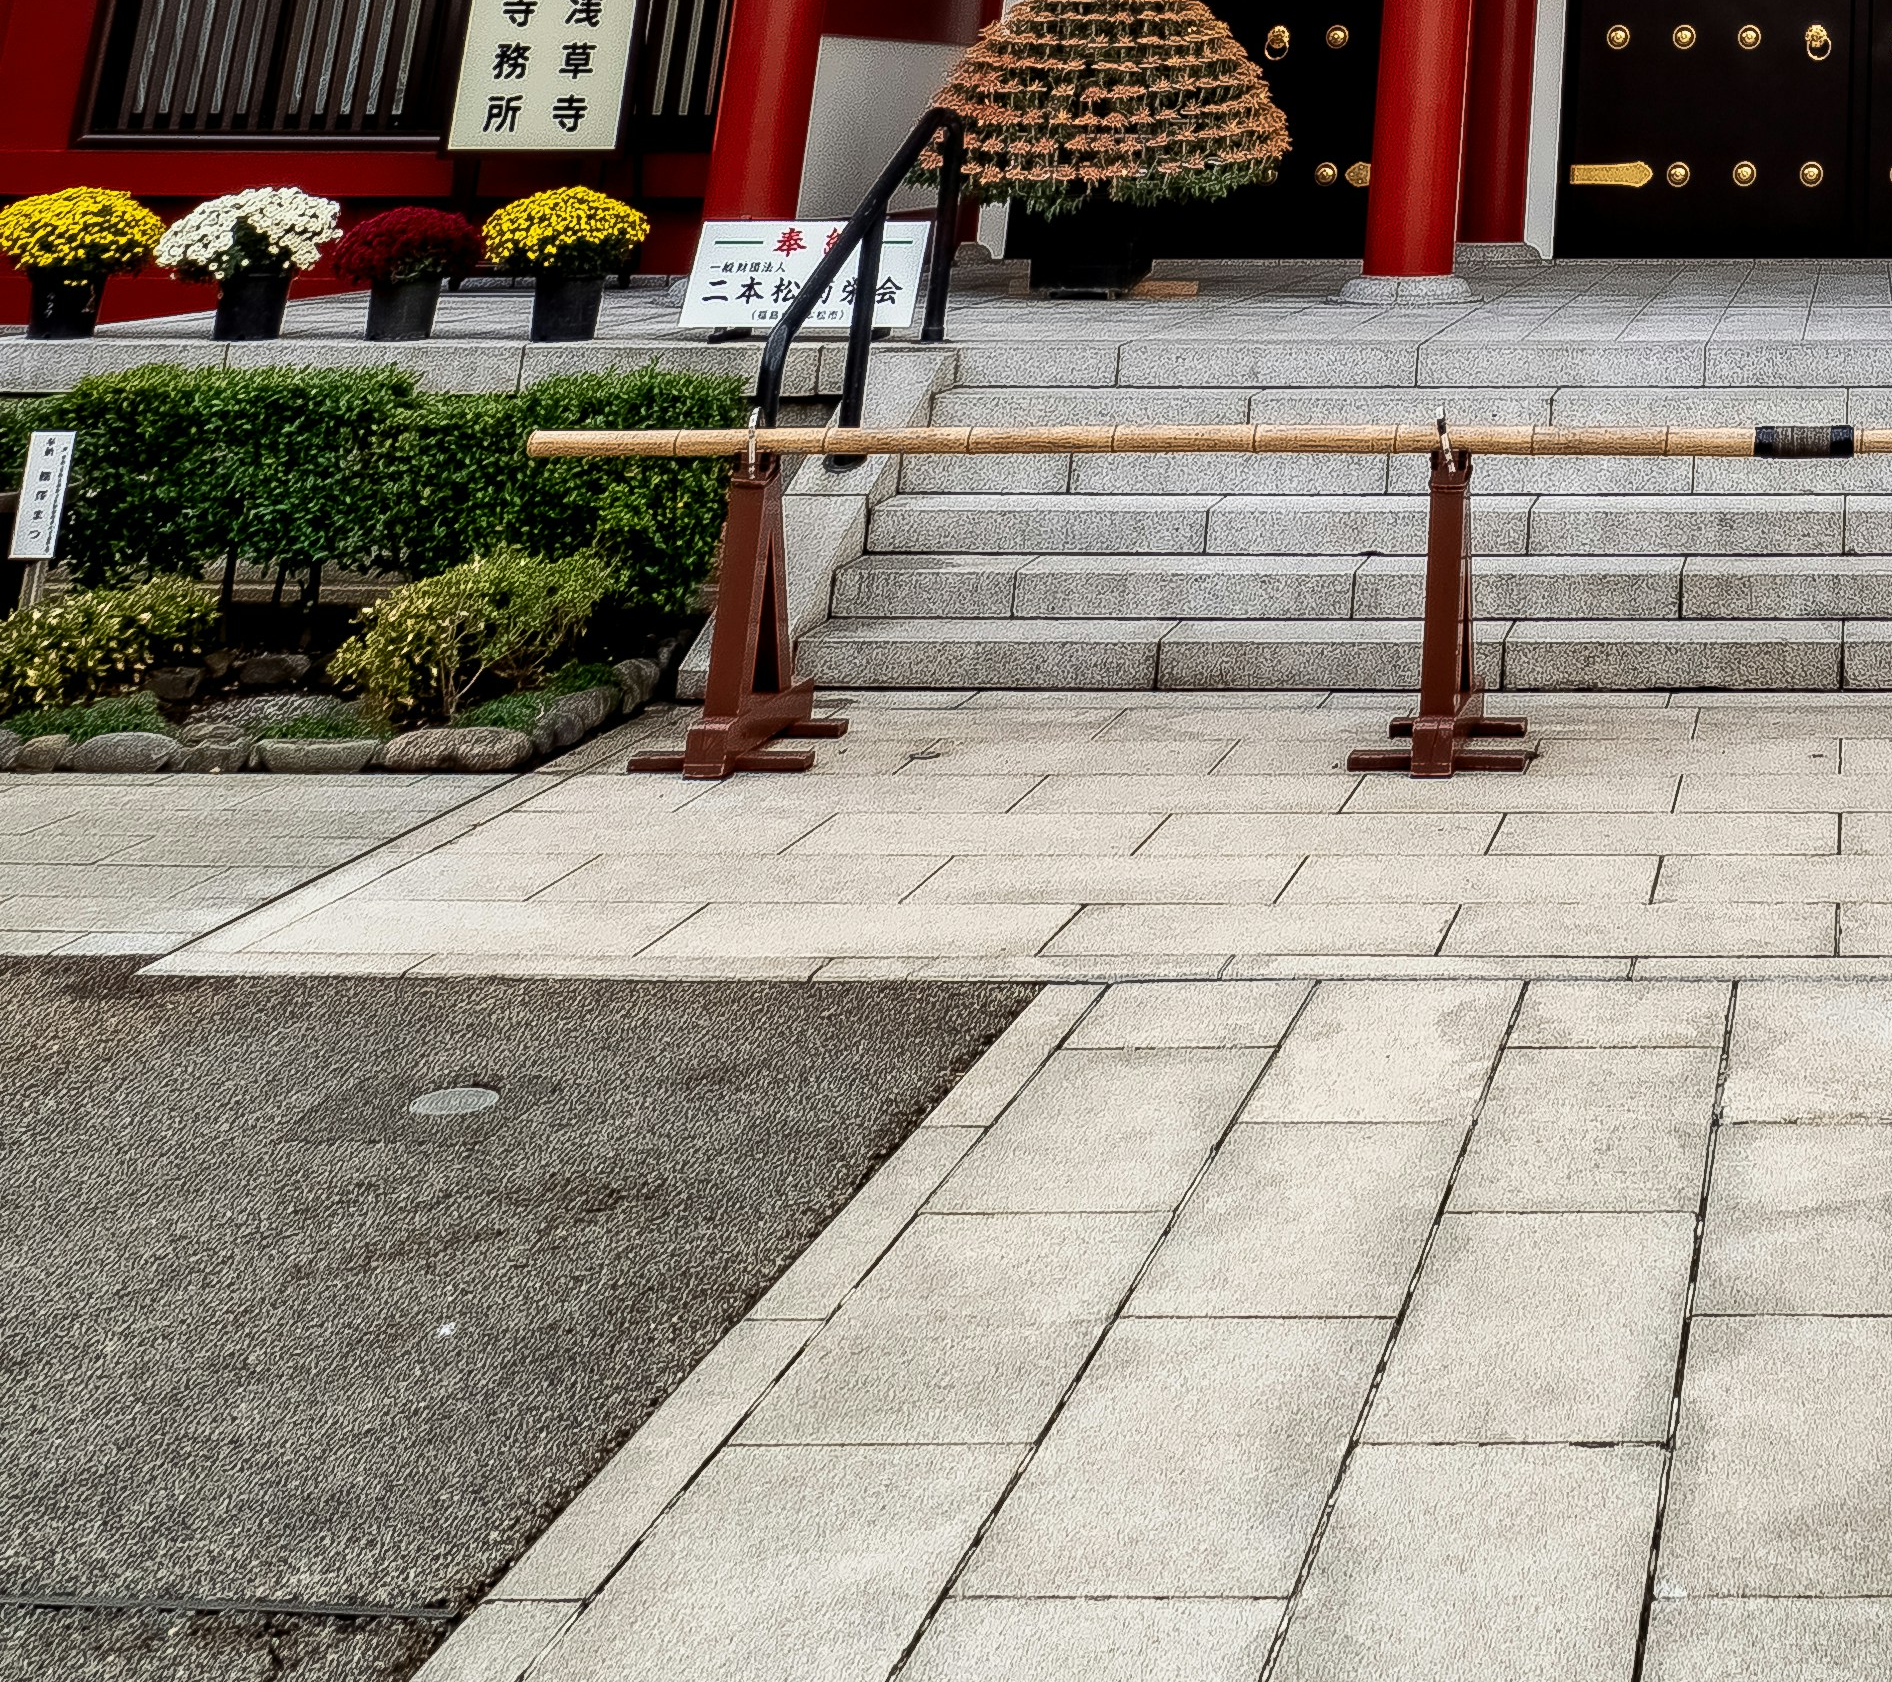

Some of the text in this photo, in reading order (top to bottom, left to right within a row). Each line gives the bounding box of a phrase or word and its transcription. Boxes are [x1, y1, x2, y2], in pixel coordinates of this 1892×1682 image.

[709, 261, 787, 274] 一般財団法人
